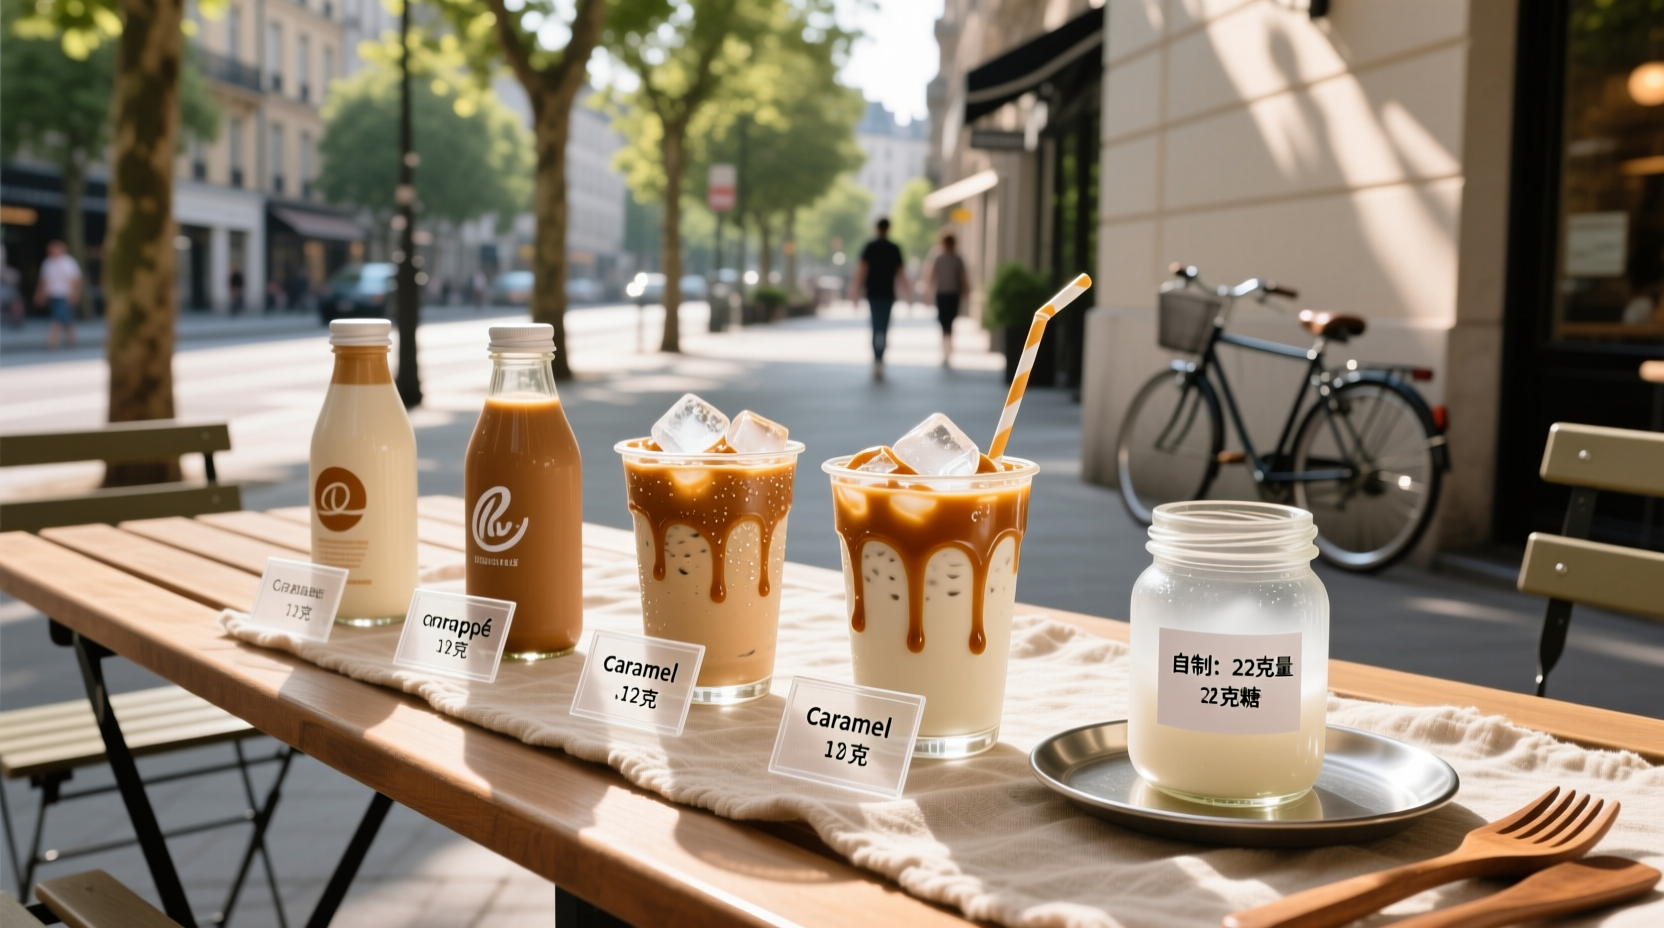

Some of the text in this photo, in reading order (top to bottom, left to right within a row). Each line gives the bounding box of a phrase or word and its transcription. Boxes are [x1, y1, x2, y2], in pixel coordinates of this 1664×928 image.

[436, 639, 468, 659] 12克
[603, 655, 679, 683] Caramel
[1200, 685, 1262, 708] 22克糖
[806, 706, 893, 739] Caramel
